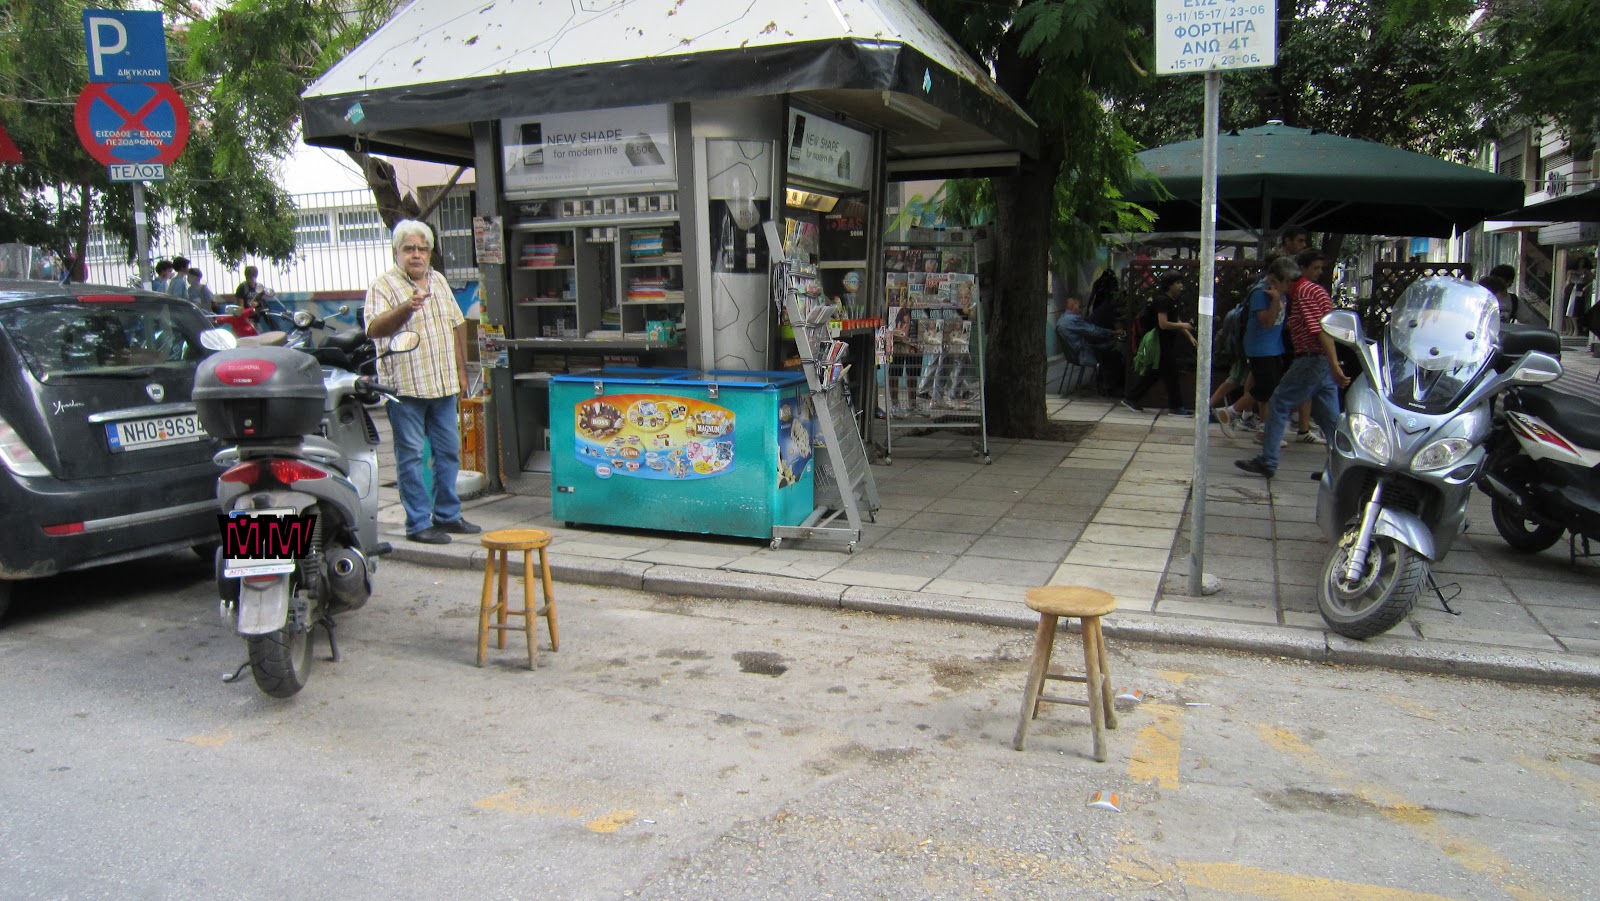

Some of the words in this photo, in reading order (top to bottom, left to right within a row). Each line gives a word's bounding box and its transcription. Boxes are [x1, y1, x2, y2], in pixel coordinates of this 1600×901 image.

[1175, 20, 1256, 38] ΦΟΡΤΗΓΑ
[90, 17, 127, 75] P
[1183, 39, 1220, 55] ΑΝΩ
[96, 130, 132, 138] ΕΙΣΟΔΟΣ
[140, 130, 172, 138] ΕΞΟΔΟΣ
[547, 133, 576, 145] NEW
[580, 129, 623, 143] SHAPE
[553, 149, 565, 158] for
[567, 147, 602, 157] modern
[604, 146, 618, 155] life
[111, 166, 164, 178] ΤΕΛΟΣ
[591, 418, 609, 426] BOSS
[697, 425, 720, 434] MAGNUM
